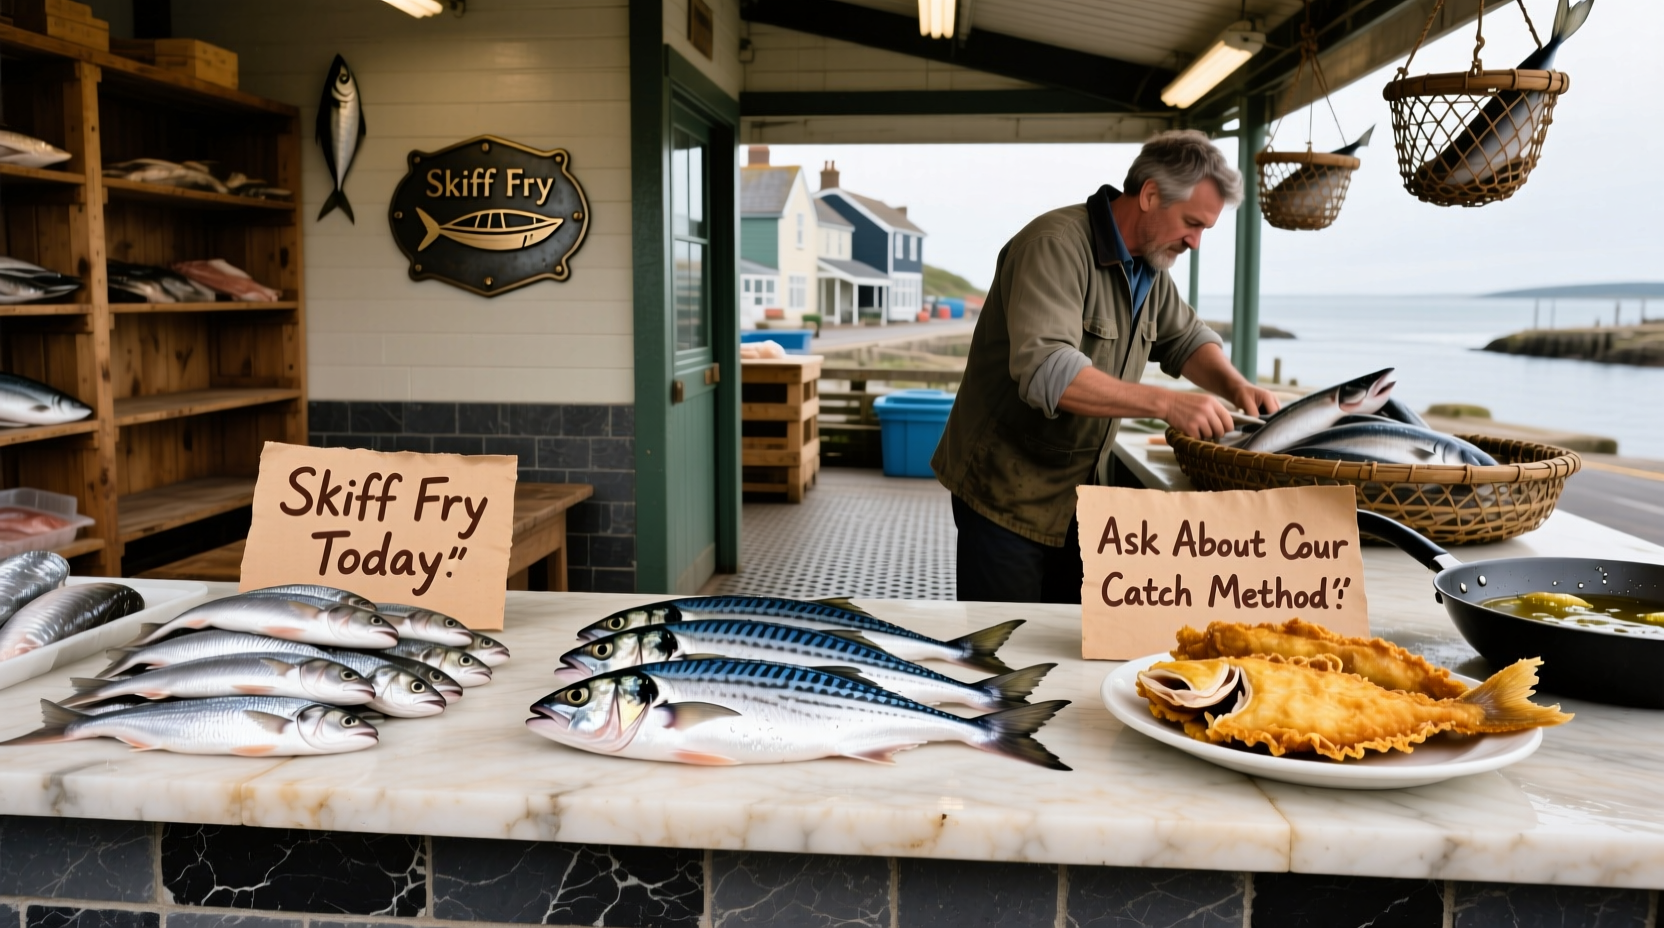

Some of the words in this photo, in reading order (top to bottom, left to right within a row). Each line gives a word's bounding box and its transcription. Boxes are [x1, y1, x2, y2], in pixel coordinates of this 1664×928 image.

[426, 167, 497, 197] Skiff
[506, 168, 554, 206] Fry
[279, 466, 403, 522] Skiff
[413, 476, 489, 540] Fry
[1097, 516, 1161, 556] Ask
[1172, 519, 1267, 558] About
[1101, 571, 1193, 608] Catch
